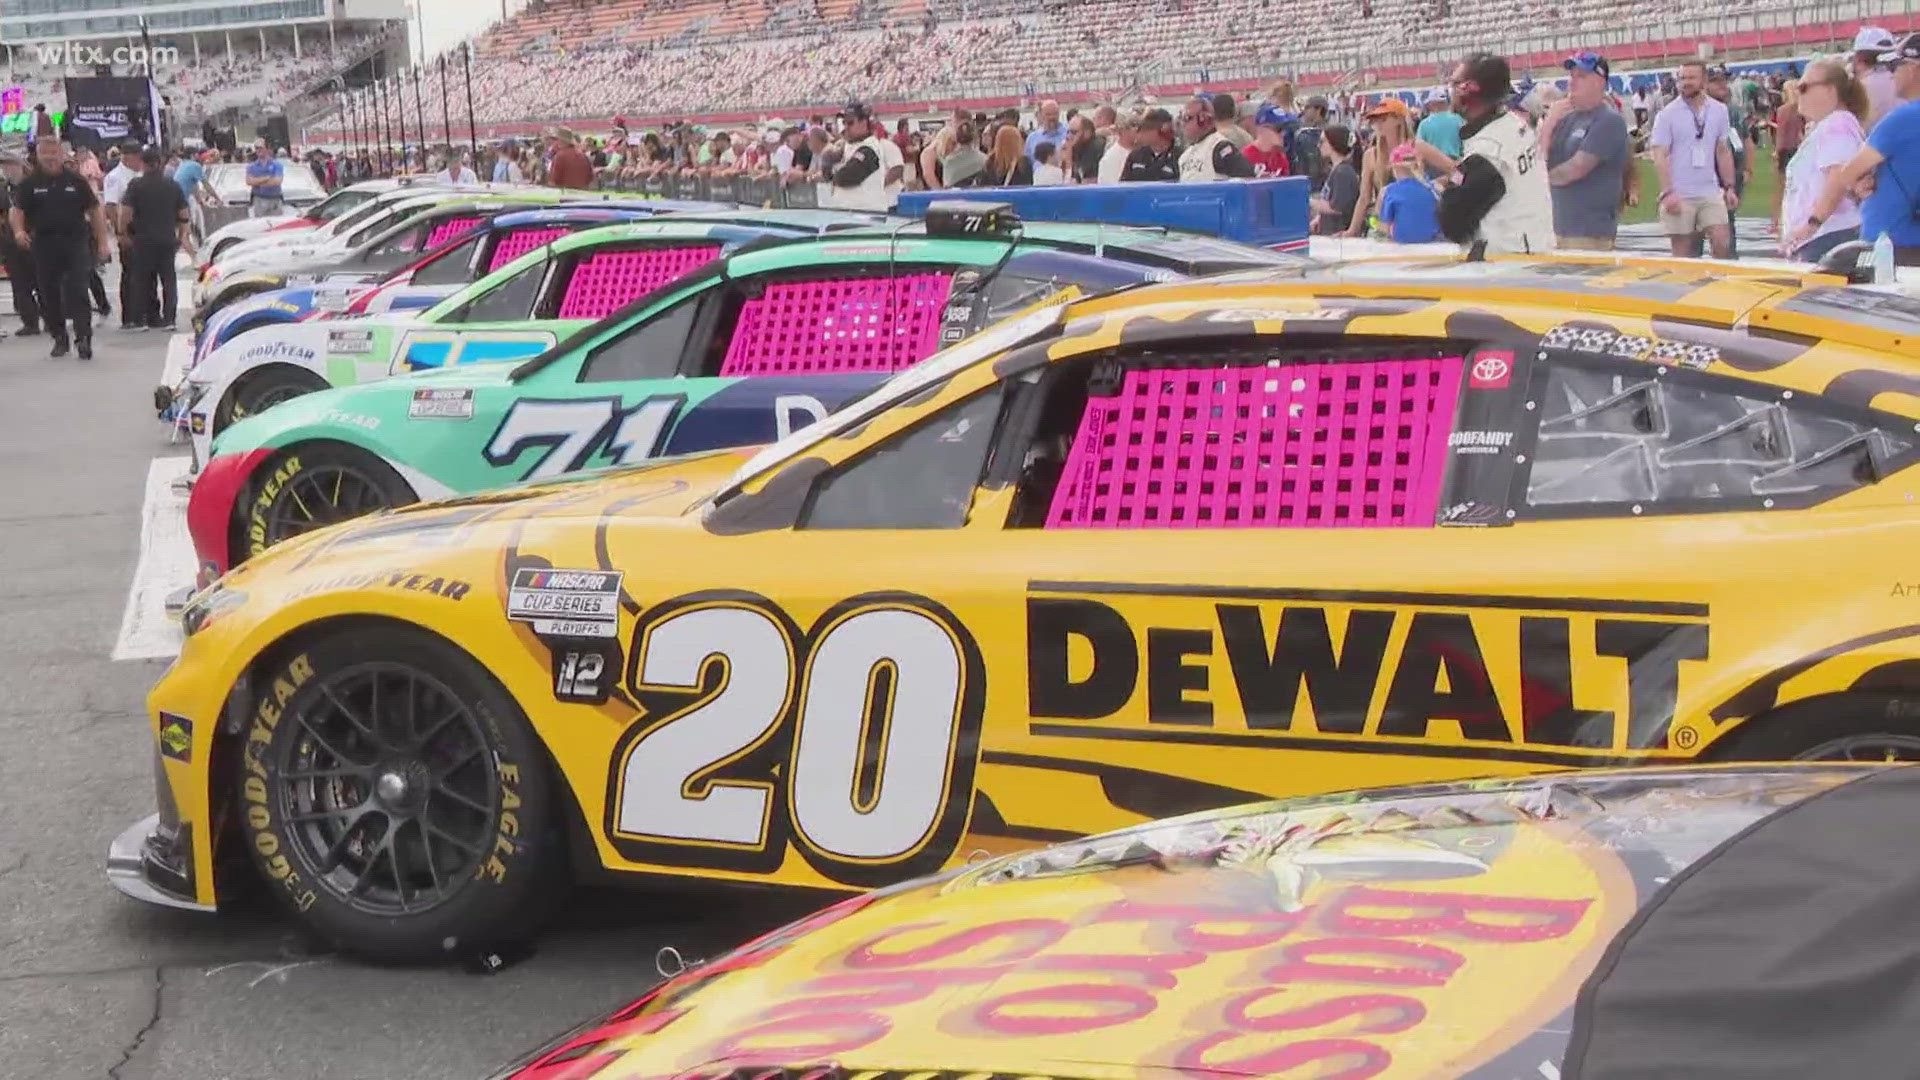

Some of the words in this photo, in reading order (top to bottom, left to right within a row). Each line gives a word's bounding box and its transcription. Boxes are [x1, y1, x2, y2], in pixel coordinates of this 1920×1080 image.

[963, 215, 983, 233] 71
[482, 393, 688, 482] 71
[546, 573, 607, 590] NASCAR
[523, 594, 550, 610] CUP
[551, 596, 603, 612] SERIES
[551, 622, 601, 634] PLAYOFFS
[556, 652, 605, 696] 12
[609, 597, 972, 870] 20
[486, 763, 522, 884] EAGLE
